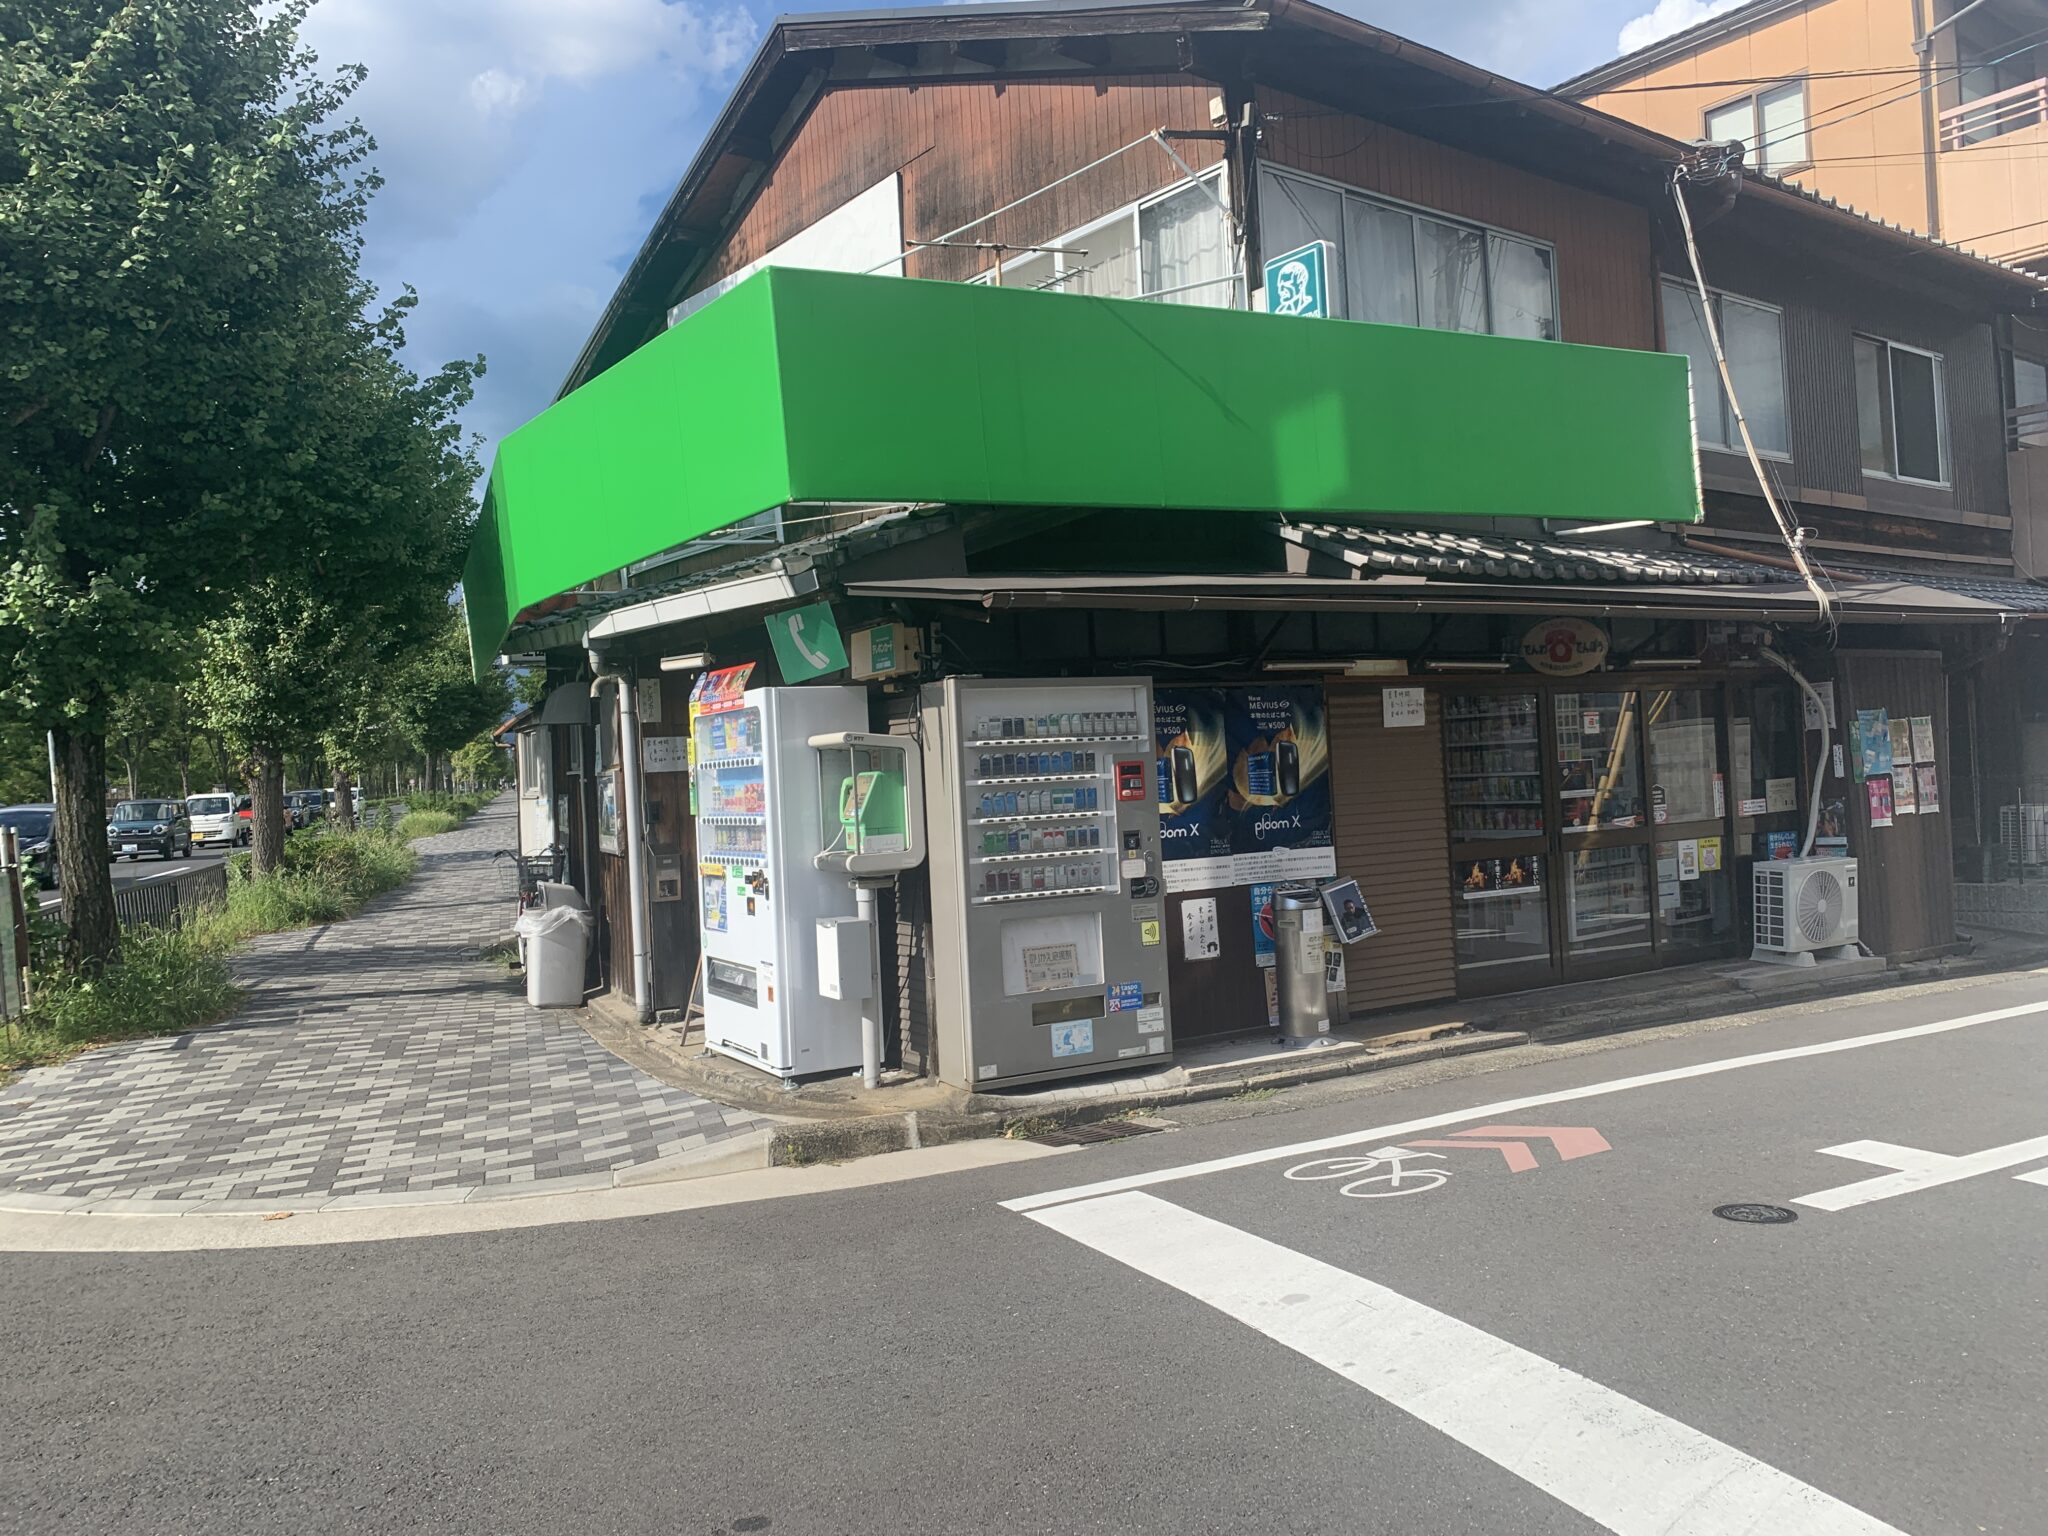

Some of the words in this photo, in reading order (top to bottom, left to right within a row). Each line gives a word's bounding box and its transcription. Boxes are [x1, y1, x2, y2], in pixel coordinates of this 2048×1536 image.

[1154, 705, 1175, 714] EVIUS
[1249, 701, 1279, 710] MEVIUS
[1268, 721, 1286, 729] ¥500
[1163, 726, 1181, 735] ¥500
[1190, 823, 1199, 836] X
[1255, 813, 1290, 840] ploom
[1292, 815, 1301, 828] X
[1121, 984, 1138, 992] taspo
